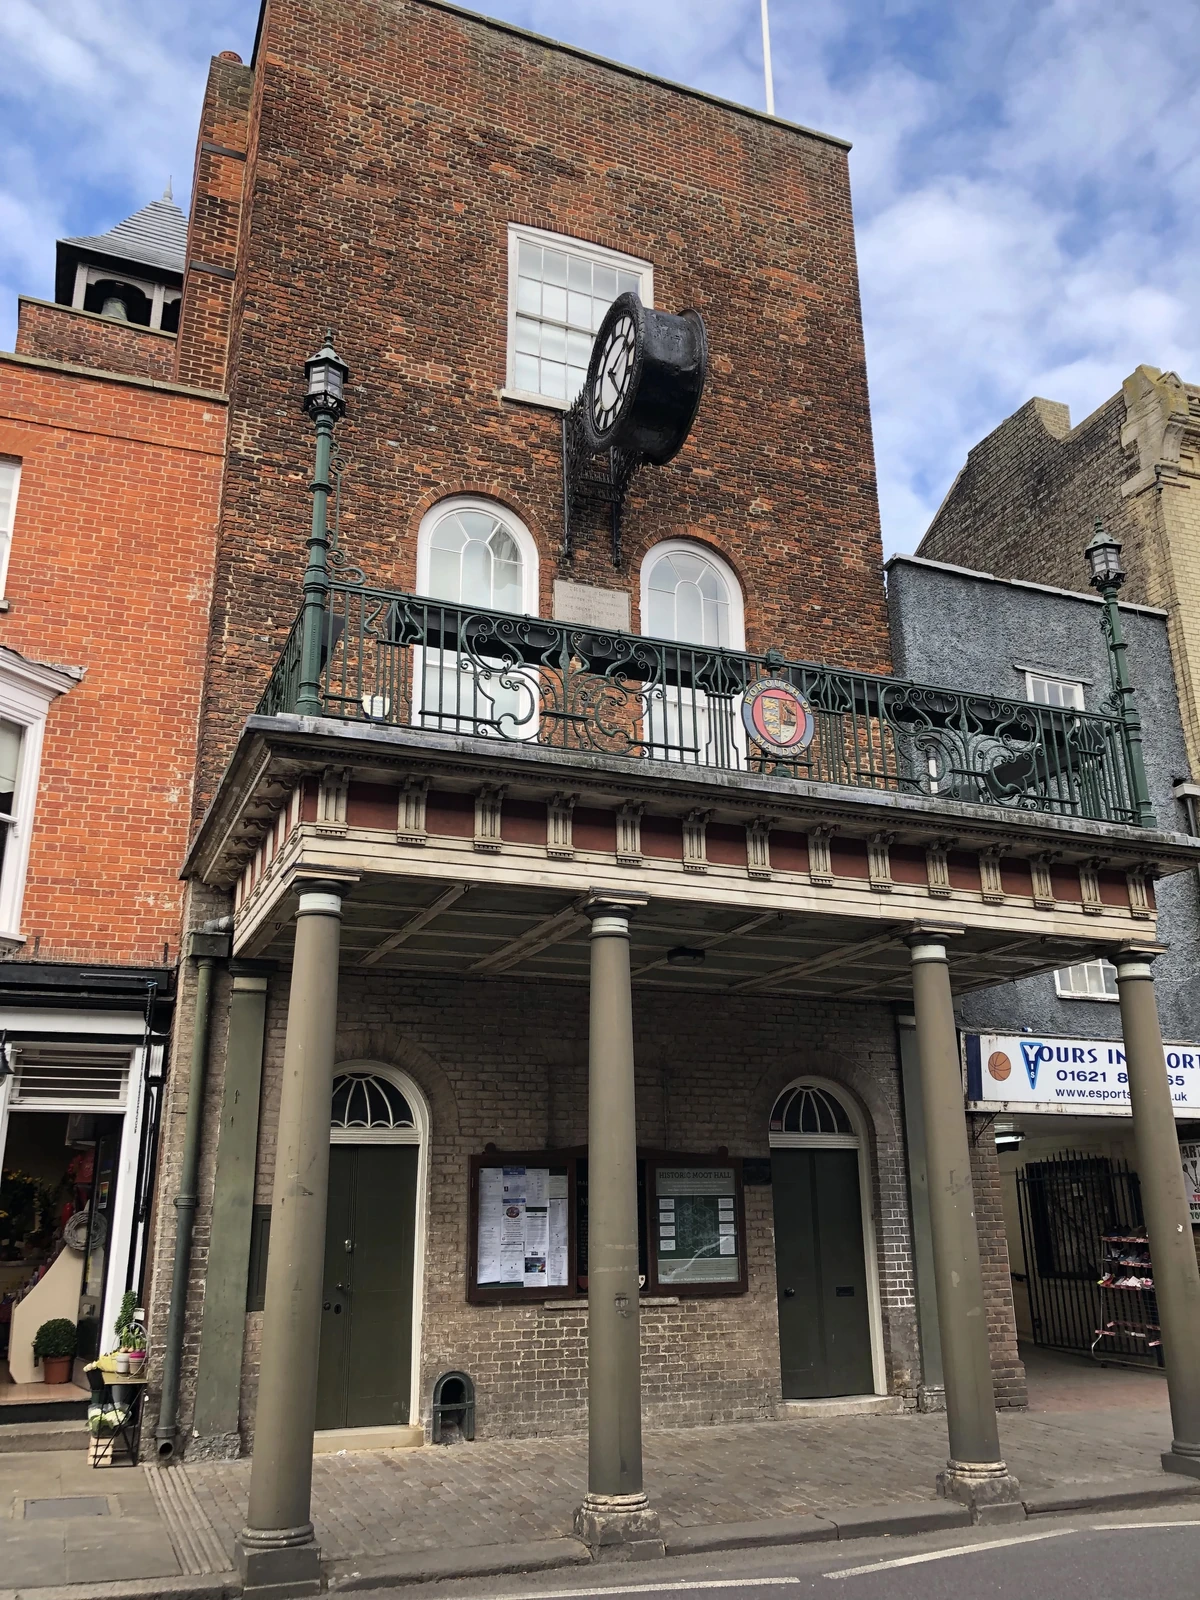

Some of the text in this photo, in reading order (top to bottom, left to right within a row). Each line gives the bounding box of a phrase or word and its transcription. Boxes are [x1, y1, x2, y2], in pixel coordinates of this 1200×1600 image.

[744, 680, 812, 714] BOROUGH OF
[755, 735, 805, 755] MALDON
[1023, 1045, 1098, 1063] YOURS
[1056, 1070, 1106, 1082] 01621
[659, 1171, 731, 1179] HISTORIC MOOT HALL
